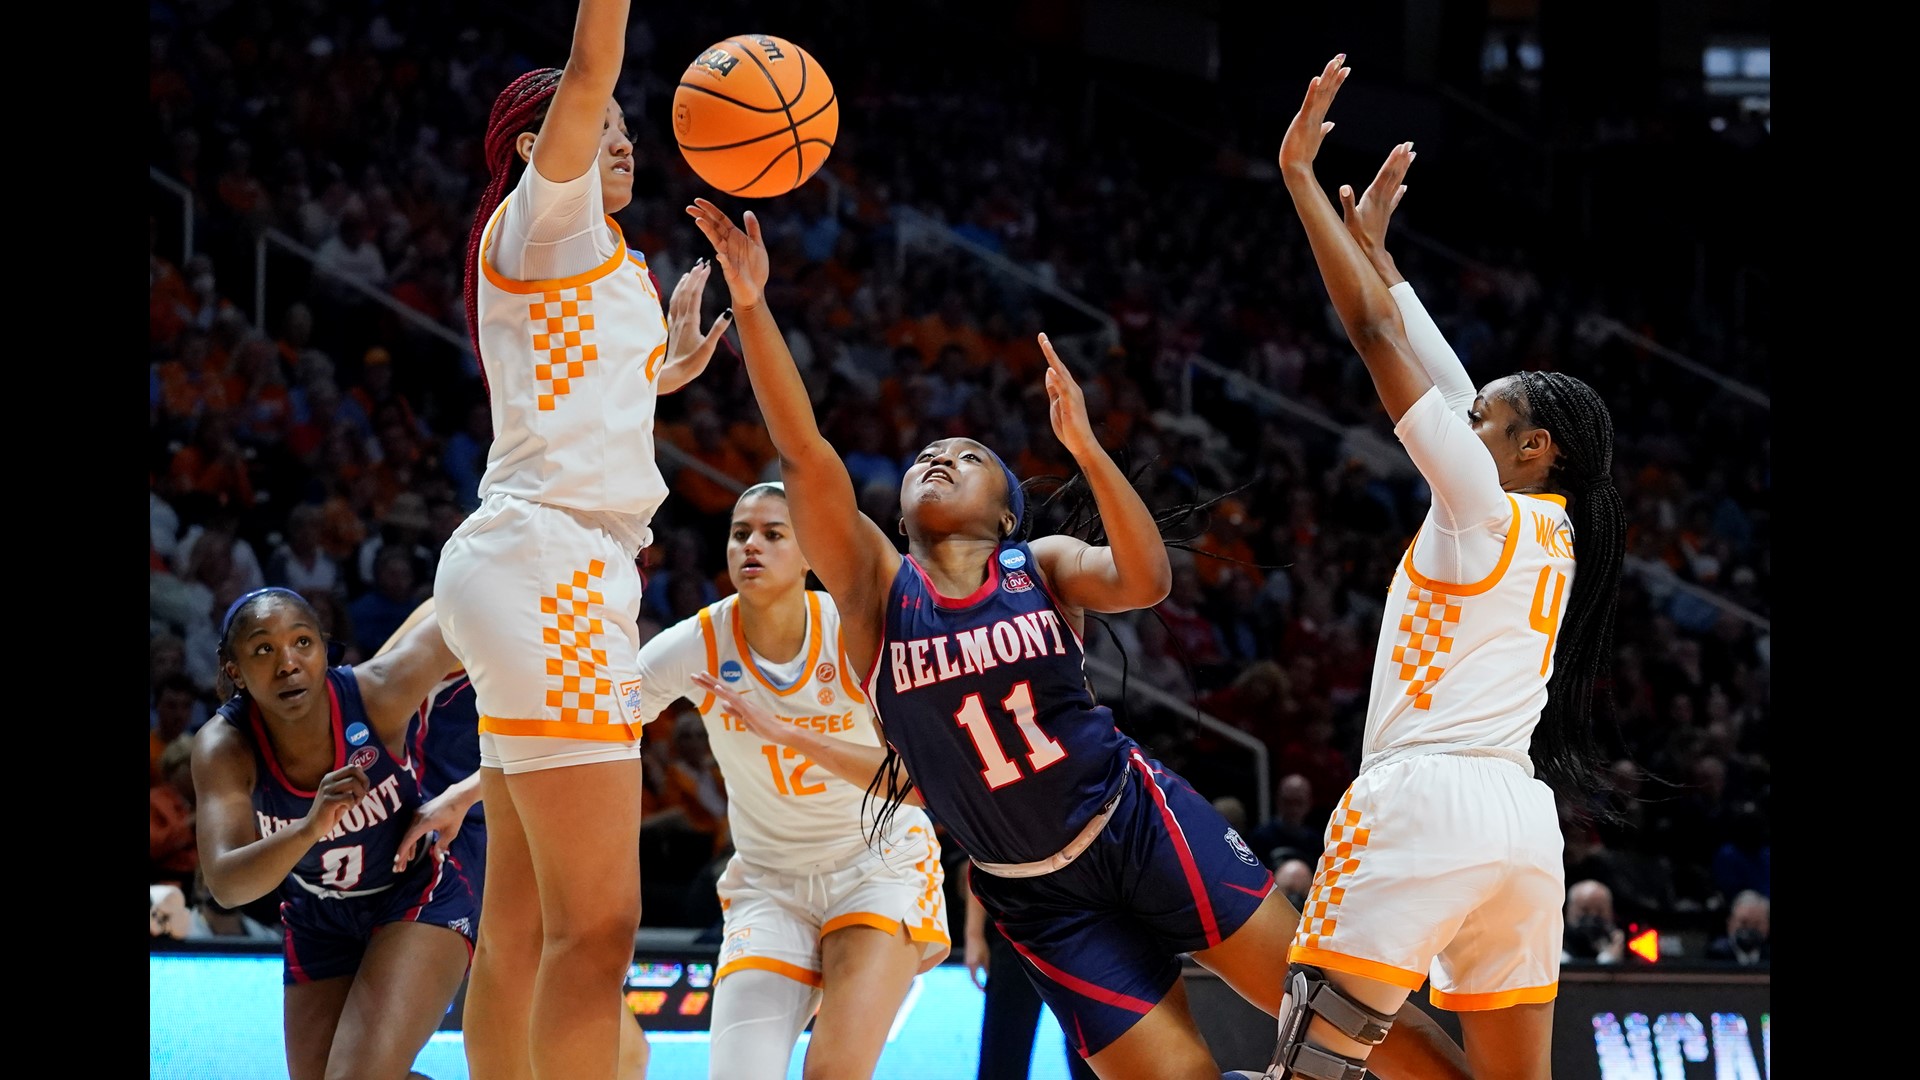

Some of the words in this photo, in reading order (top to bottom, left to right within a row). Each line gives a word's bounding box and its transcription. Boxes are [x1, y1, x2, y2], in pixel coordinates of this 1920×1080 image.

[692, 48, 740, 77] CAA
[1003, 555, 1026, 565] NCAA
[1010, 577, 1027, 588] OVC
[1529, 565, 1566, 678] 4
[890, 610, 1067, 694] BELMONT
[351, 729, 369, 743] NCAA
[719, 711, 856, 734] TESSEE
[953, 680, 1069, 793] 11
[761, 745, 828, 796] 12
[321, 844, 364, 891] 0
